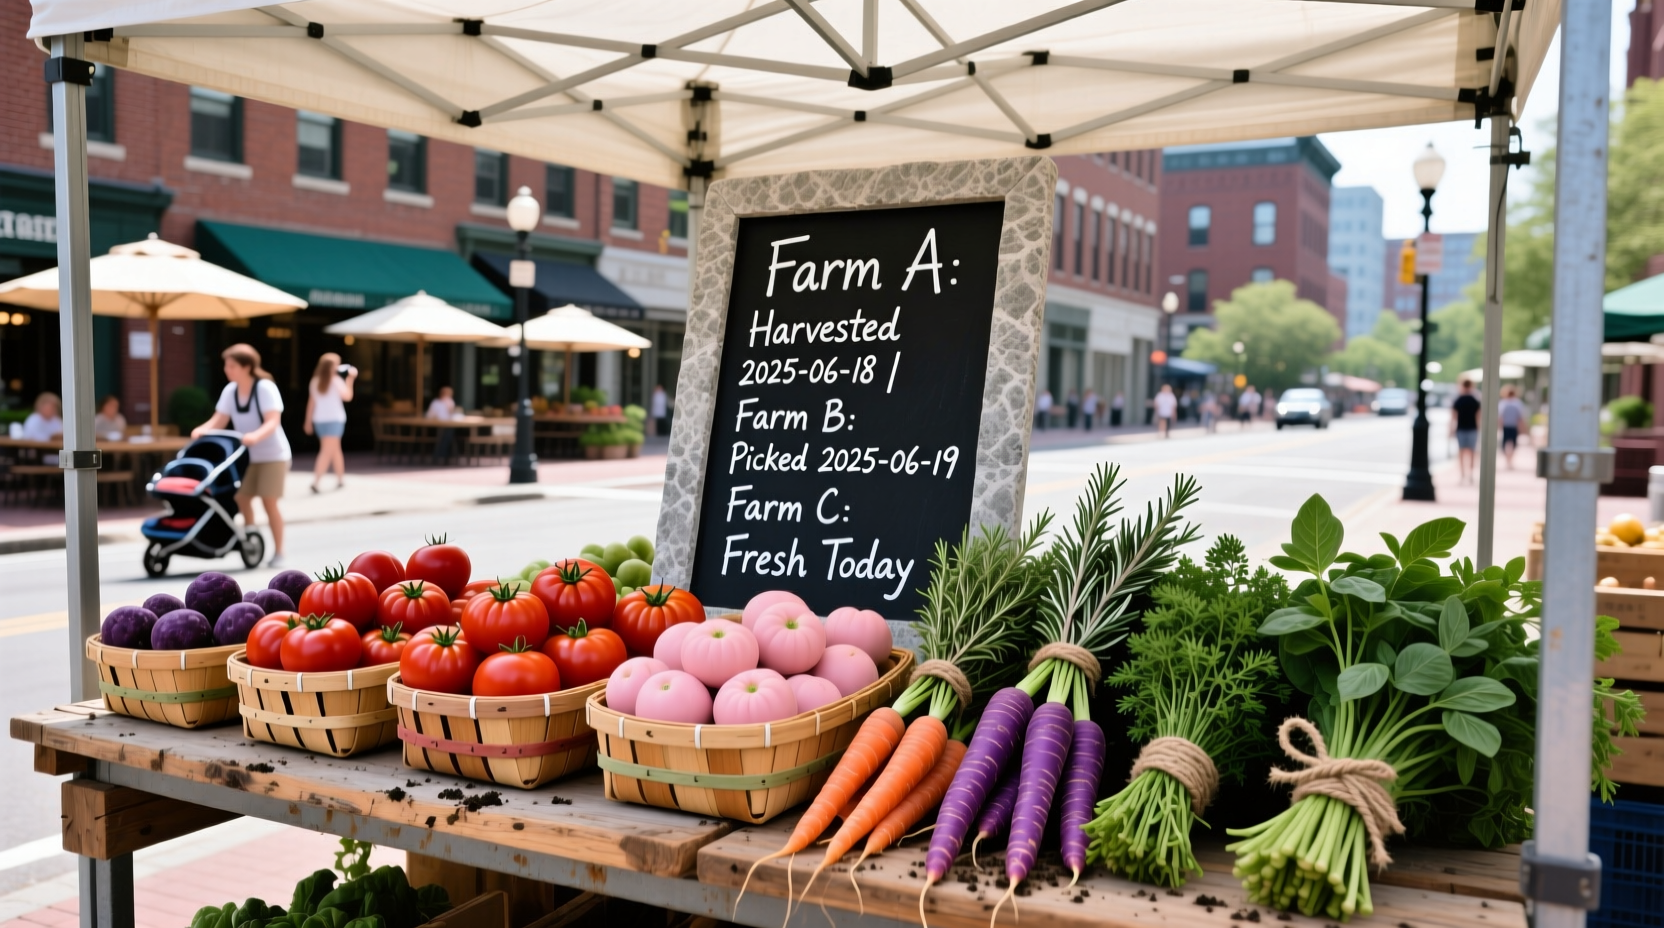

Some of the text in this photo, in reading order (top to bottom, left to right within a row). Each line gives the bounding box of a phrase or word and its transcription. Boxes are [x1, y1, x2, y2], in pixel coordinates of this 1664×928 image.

[766, 228, 960, 297] Farm A:
[750, 306, 901, 347] Harvested
[739, 355, 877, 386] 2025-06-18
[736, 398, 856, 432] Farm B:
[729, 441, 960, 479] Picked 2025-06-19
[727, 485, 851, 525] Farm C:
[721, 533, 914, 600] Fresh Today
